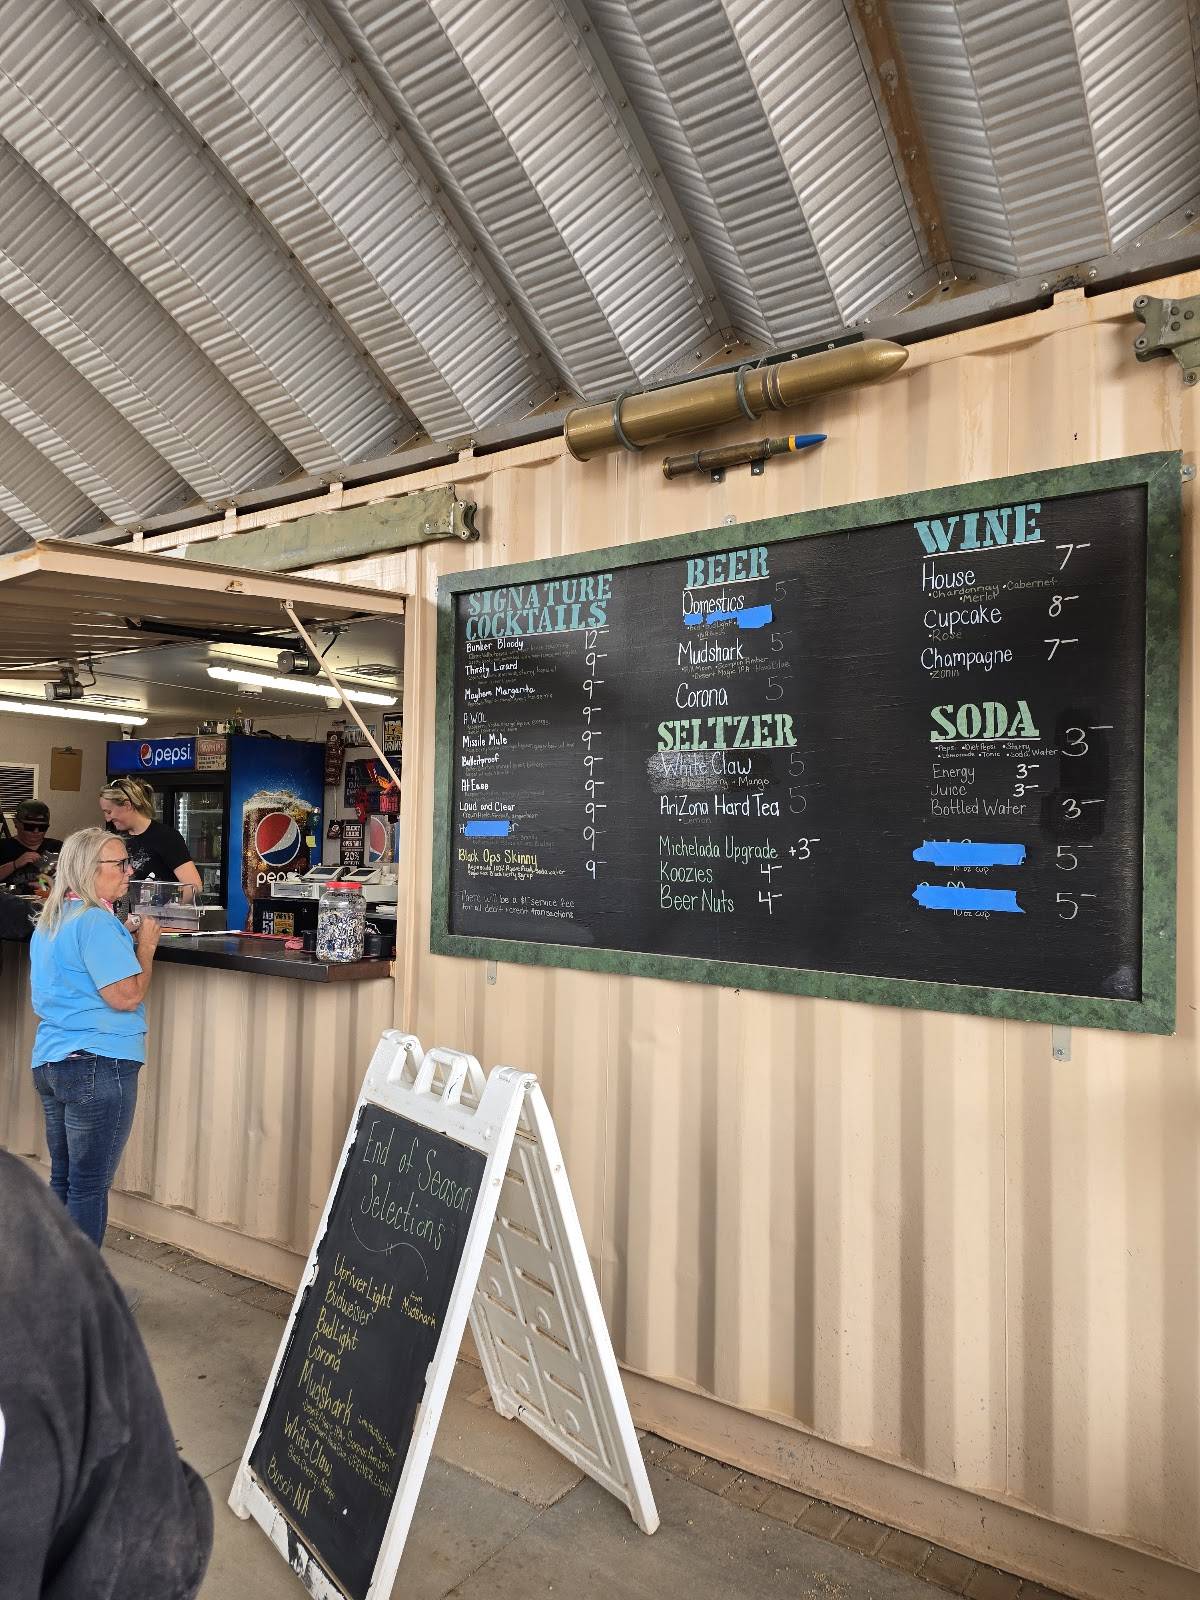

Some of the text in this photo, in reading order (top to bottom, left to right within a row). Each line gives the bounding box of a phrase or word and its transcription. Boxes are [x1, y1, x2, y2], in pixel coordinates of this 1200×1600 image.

[914, 503, 1041, 554] WINE
[686, 547, 770, 589] BEER
[922, 562, 976, 591] House
[468, 574, 613, 616] SIGNATURE
[932, 578, 1057, 599] Chardonnay Cabernet
[963, 592, 998, 603] Merlot
[682, 588, 745, 616] Domestics
[466, 601, 607, 642] COCKTAILS
[924, 605, 1003, 634] Cupcake
[467, 641, 493, 653] Bunker
[497, 639, 524, 651] Bloody
[678, 638, 744, 666] Mudshark
[465, 665, 490, 679] Thirsty
[493, 660, 518, 671] Lizard
[920, 647, 1013, 672] Champagne
[465, 687, 493, 702] Mayhem
[496, 684, 536, 699] Margarita
[675, 682, 728, 708] Corona
[657, 714, 798, 751] SELTZER
[930, 700, 1040, 742] SODA
[463, 735, 486, 749] Missile
[489, 733, 508, 746] Mule
[964, 743, 980, 751] Diet
[980, 744, 996, 752] Pepsi
[1006, 743, 1030, 753] Starry
[1031, 749, 1059, 757] Water
[155, 743, 191, 766] pepsi
[660, 752, 708, 777] White
[712, 751, 752, 775] Claw
[471, 779, 489, 790] Ease
[738, 777, 770, 791] Mango
[932, 764, 976, 785] Energy
[930, 784, 968, 796] Juice
[459, 802, 477, 811] Loud
[481, 802, 493, 811] and
[494, 801, 516, 812] Clear
[660, 795, 709, 816] AriZona
[715, 794, 750, 816] Hard
[752, 793, 780, 817] Tea
[930, 798, 979, 816] Bottled
[983, 799, 1027, 816] Water
[458, 848, 479, 862] Black
[483, 849, 501, 864] Ops
[504, 850, 538, 870] Skinny
[659, 835, 720, 858] Michelada
[725, 836, 779, 865] Upgrade
[256, 868, 298, 888] pep
[660, 860, 713, 883] Koozies
[975, 866, 989, 875] cup
[500, 894, 510, 903] be
[660, 883, 698, 911] Beer
[701, 888, 735, 913] Nuts
[531, 907, 575, 919] transactions
[975, 911, 991, 920] cup
[362, 1120, 473, 1214] End of Season
[360, 1174, 446, 1251] Selections
[325, 1280, 374, 1326] Budweiser
[366, 1276, 394, 1313] Light
[401, 1296, 437, 1330] Mudshark
[308, 1331, 342, 1373] Corona
[298, 1358, 354, 1426] Mudshark
[284, 1411, 310, 1457] White
[309, 1439, 333, 1477] Claw
[293, 1483, 311, 1517] NA
